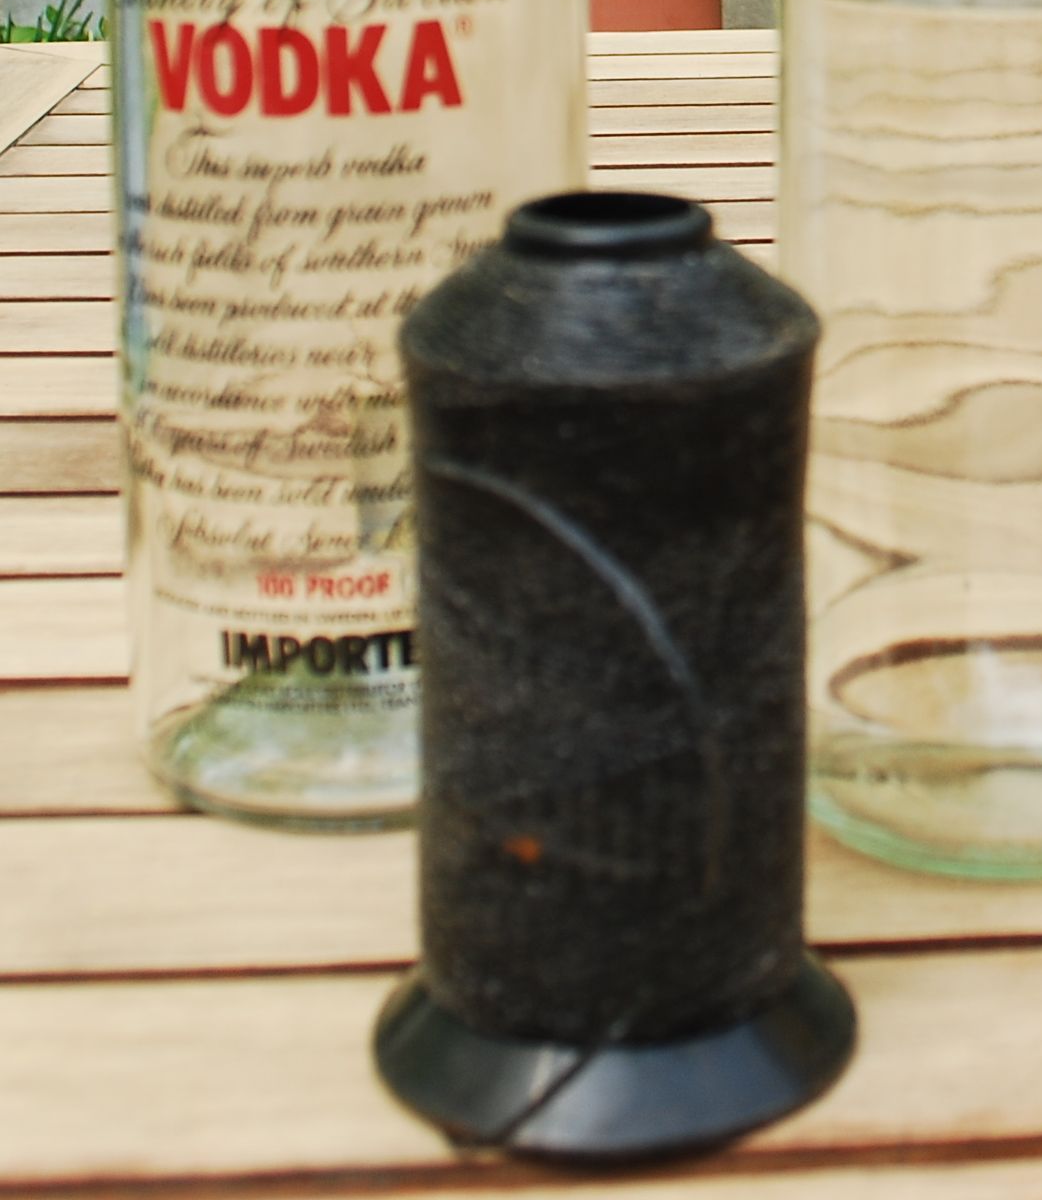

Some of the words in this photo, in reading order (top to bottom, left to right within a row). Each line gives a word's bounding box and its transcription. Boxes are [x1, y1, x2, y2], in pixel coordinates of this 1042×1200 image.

[149, 19, 464, 117] VODKA
[166, 126, 231, 179] This
[341, 143, 428, 177] vodka
[246, 199, 318, 241] from
[323, 200, 406, 242] grain
[409, 190, 493, 238] grown
[258, 244, 295, 290] of
[299, 237, 423, 272] southern
[218, 290, 352, 327] produced
[355, 291, 389, 318] at
[391, 286, 421, 315] th
[257, 570, 295, 598] 100
[305, 570, 391, 599] PROOF
